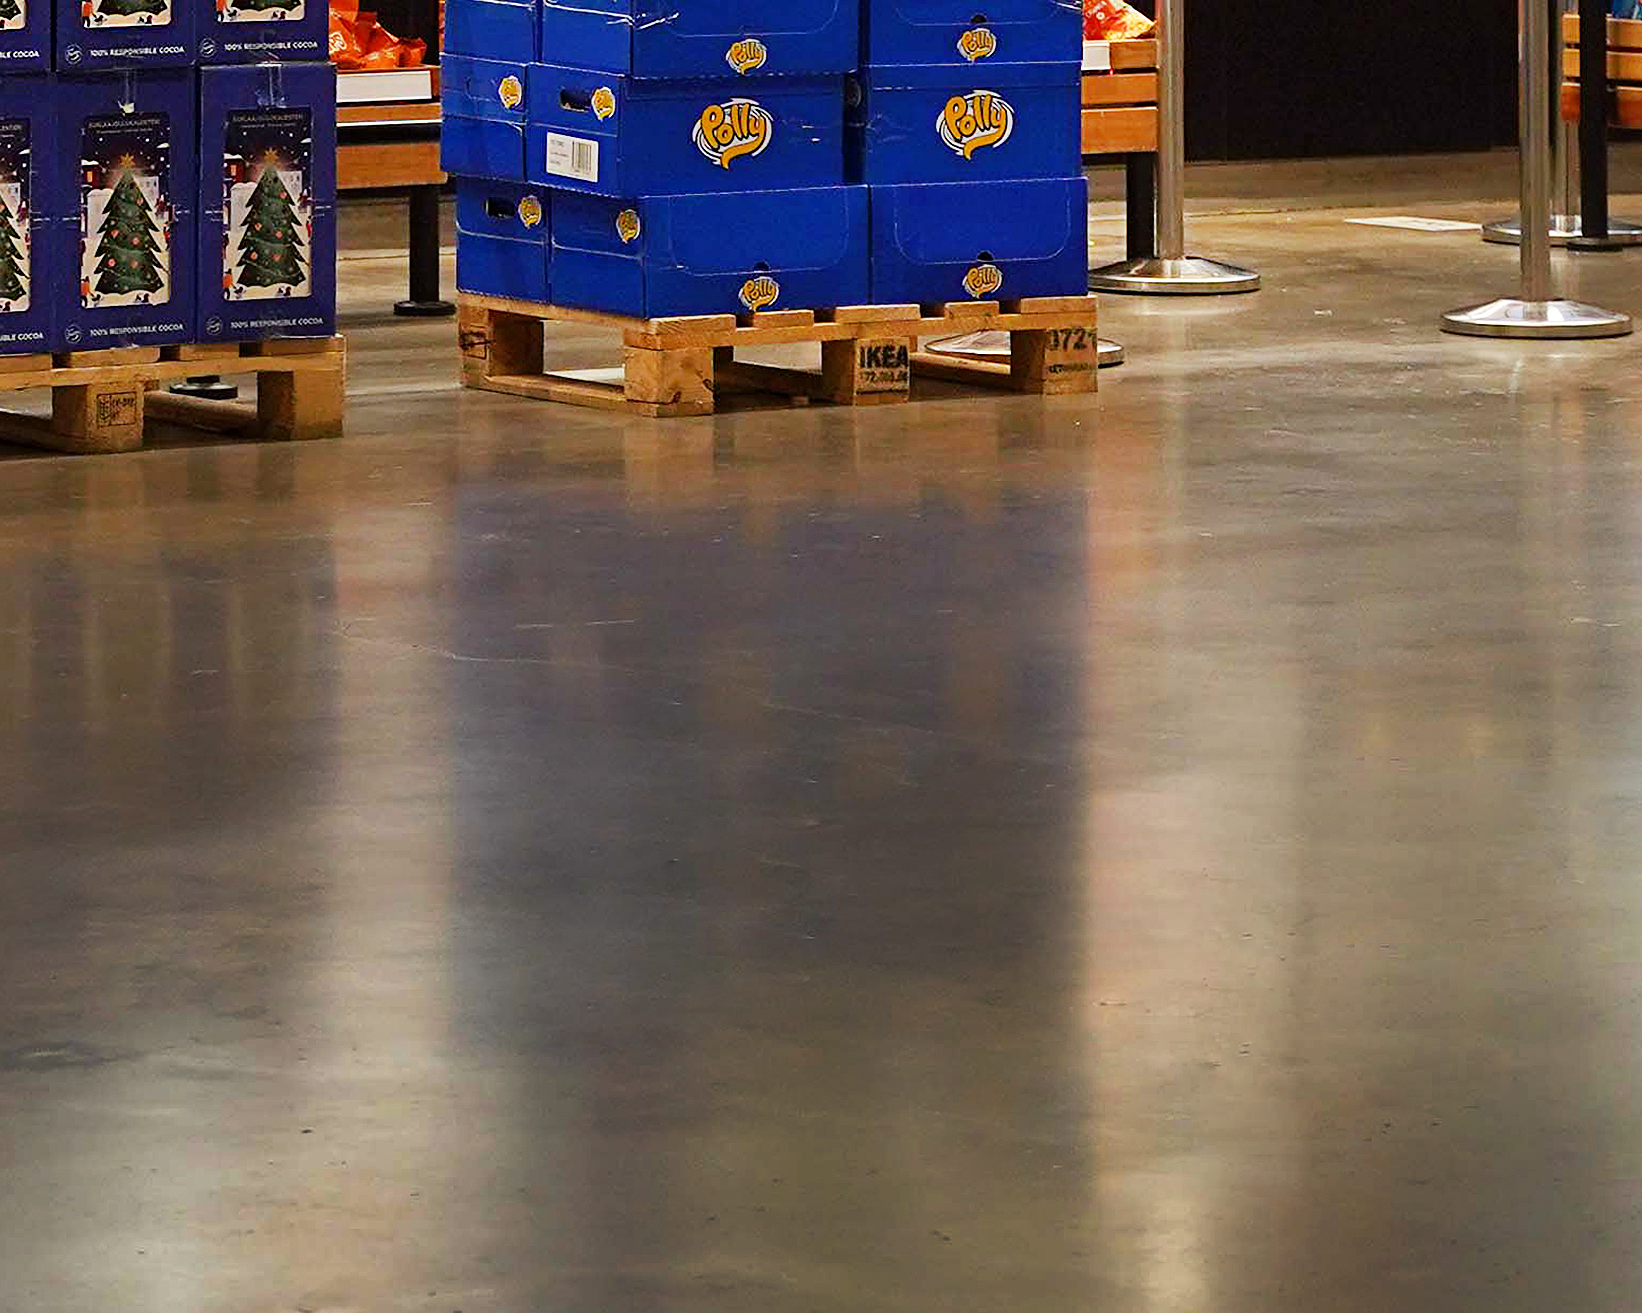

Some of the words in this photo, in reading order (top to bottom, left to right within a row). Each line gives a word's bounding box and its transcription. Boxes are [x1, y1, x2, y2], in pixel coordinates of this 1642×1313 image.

[159, 46, 184, 54] COCOA
[701, 102, 767, 170] Polly
[944, 90, 1007, 160] Polly
[964, 266, 1001, 299] Polly
[859, 345, 908, 369] IKEA
